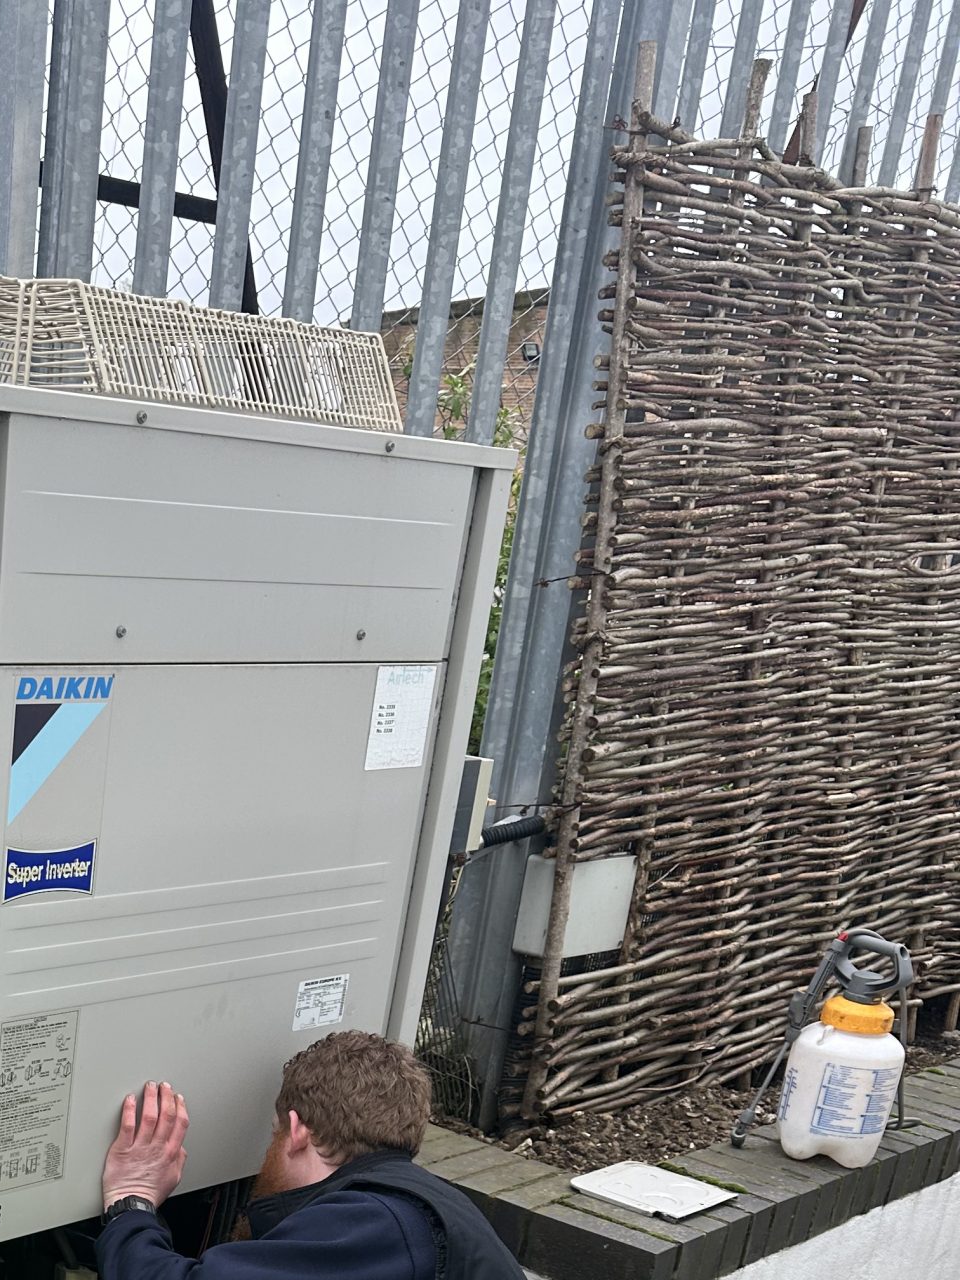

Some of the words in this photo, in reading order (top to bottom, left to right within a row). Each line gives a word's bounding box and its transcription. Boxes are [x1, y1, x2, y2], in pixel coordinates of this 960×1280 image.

[16, 677, 113, 700] DAIKIN
[7, 861, 44, 888] Super
[45, 857, 91, 880] Inverter
